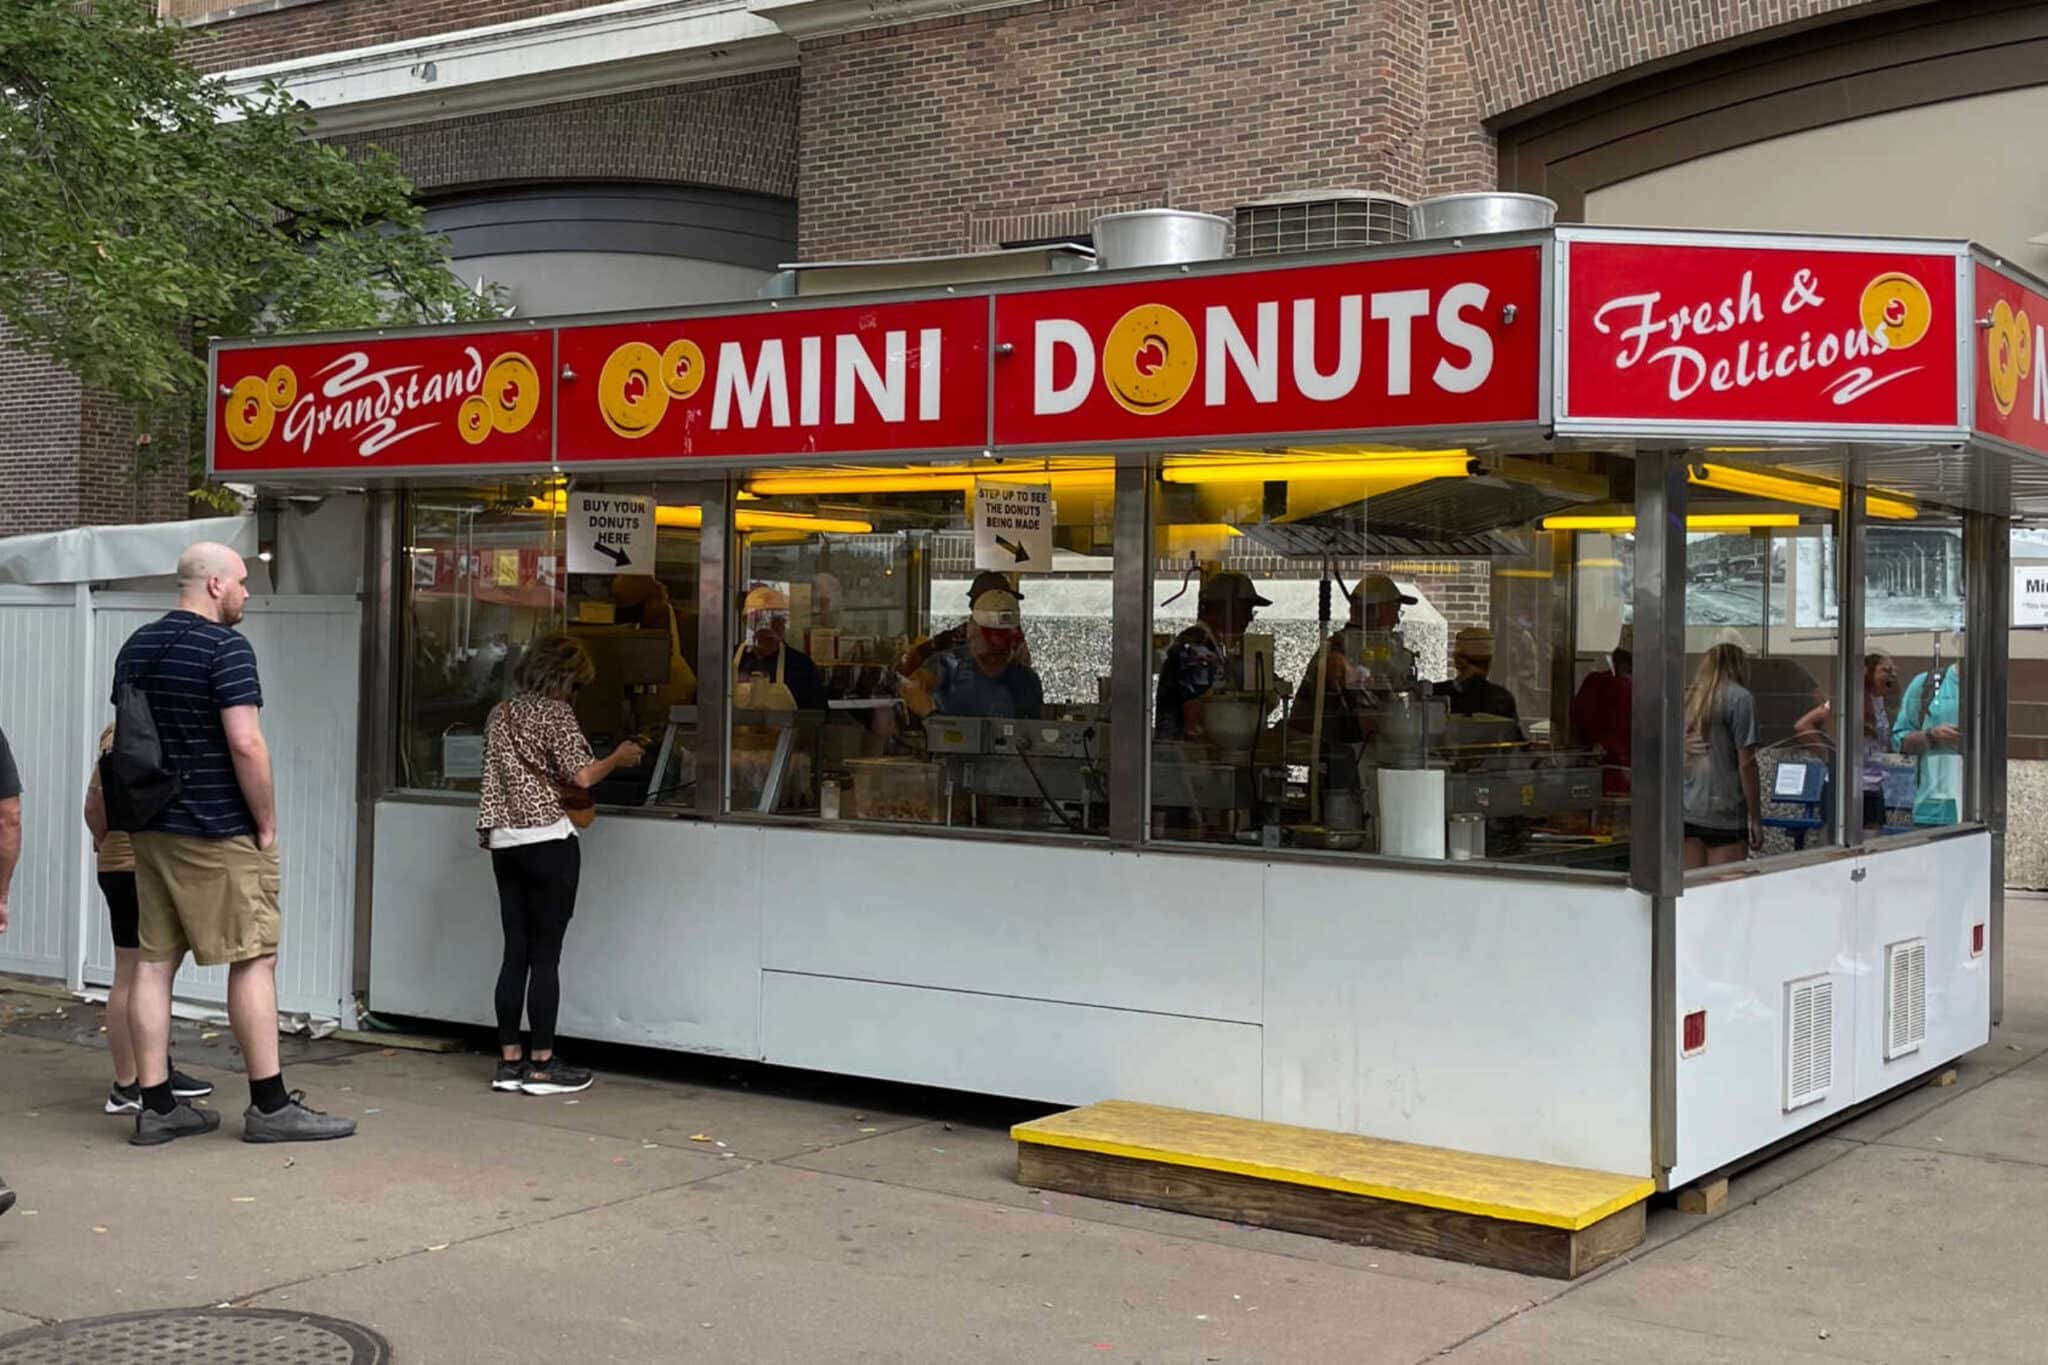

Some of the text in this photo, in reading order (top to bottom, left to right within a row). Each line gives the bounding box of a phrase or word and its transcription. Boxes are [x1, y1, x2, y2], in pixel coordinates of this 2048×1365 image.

[1593, 268, 1825, 369] Fresh &
[710, 282, 1494, 430] MINI DONUTS
[1648, 321, 1889, 401] Delicious
[282, 346, 483, 453] Grandstand
[978, 488, 1047, 503] STEP UP TO SEE
[583, 499, 645, 514] BUY YOUR
[986, 503, 1041, 516] THE DONUTS
[589, 515, 640, 529] DONUTS
[986, 517, 1040, 530] BEING MADE
[598, 532, 631, 544] HERE
[2026, 579, 2048, 593] Mi
